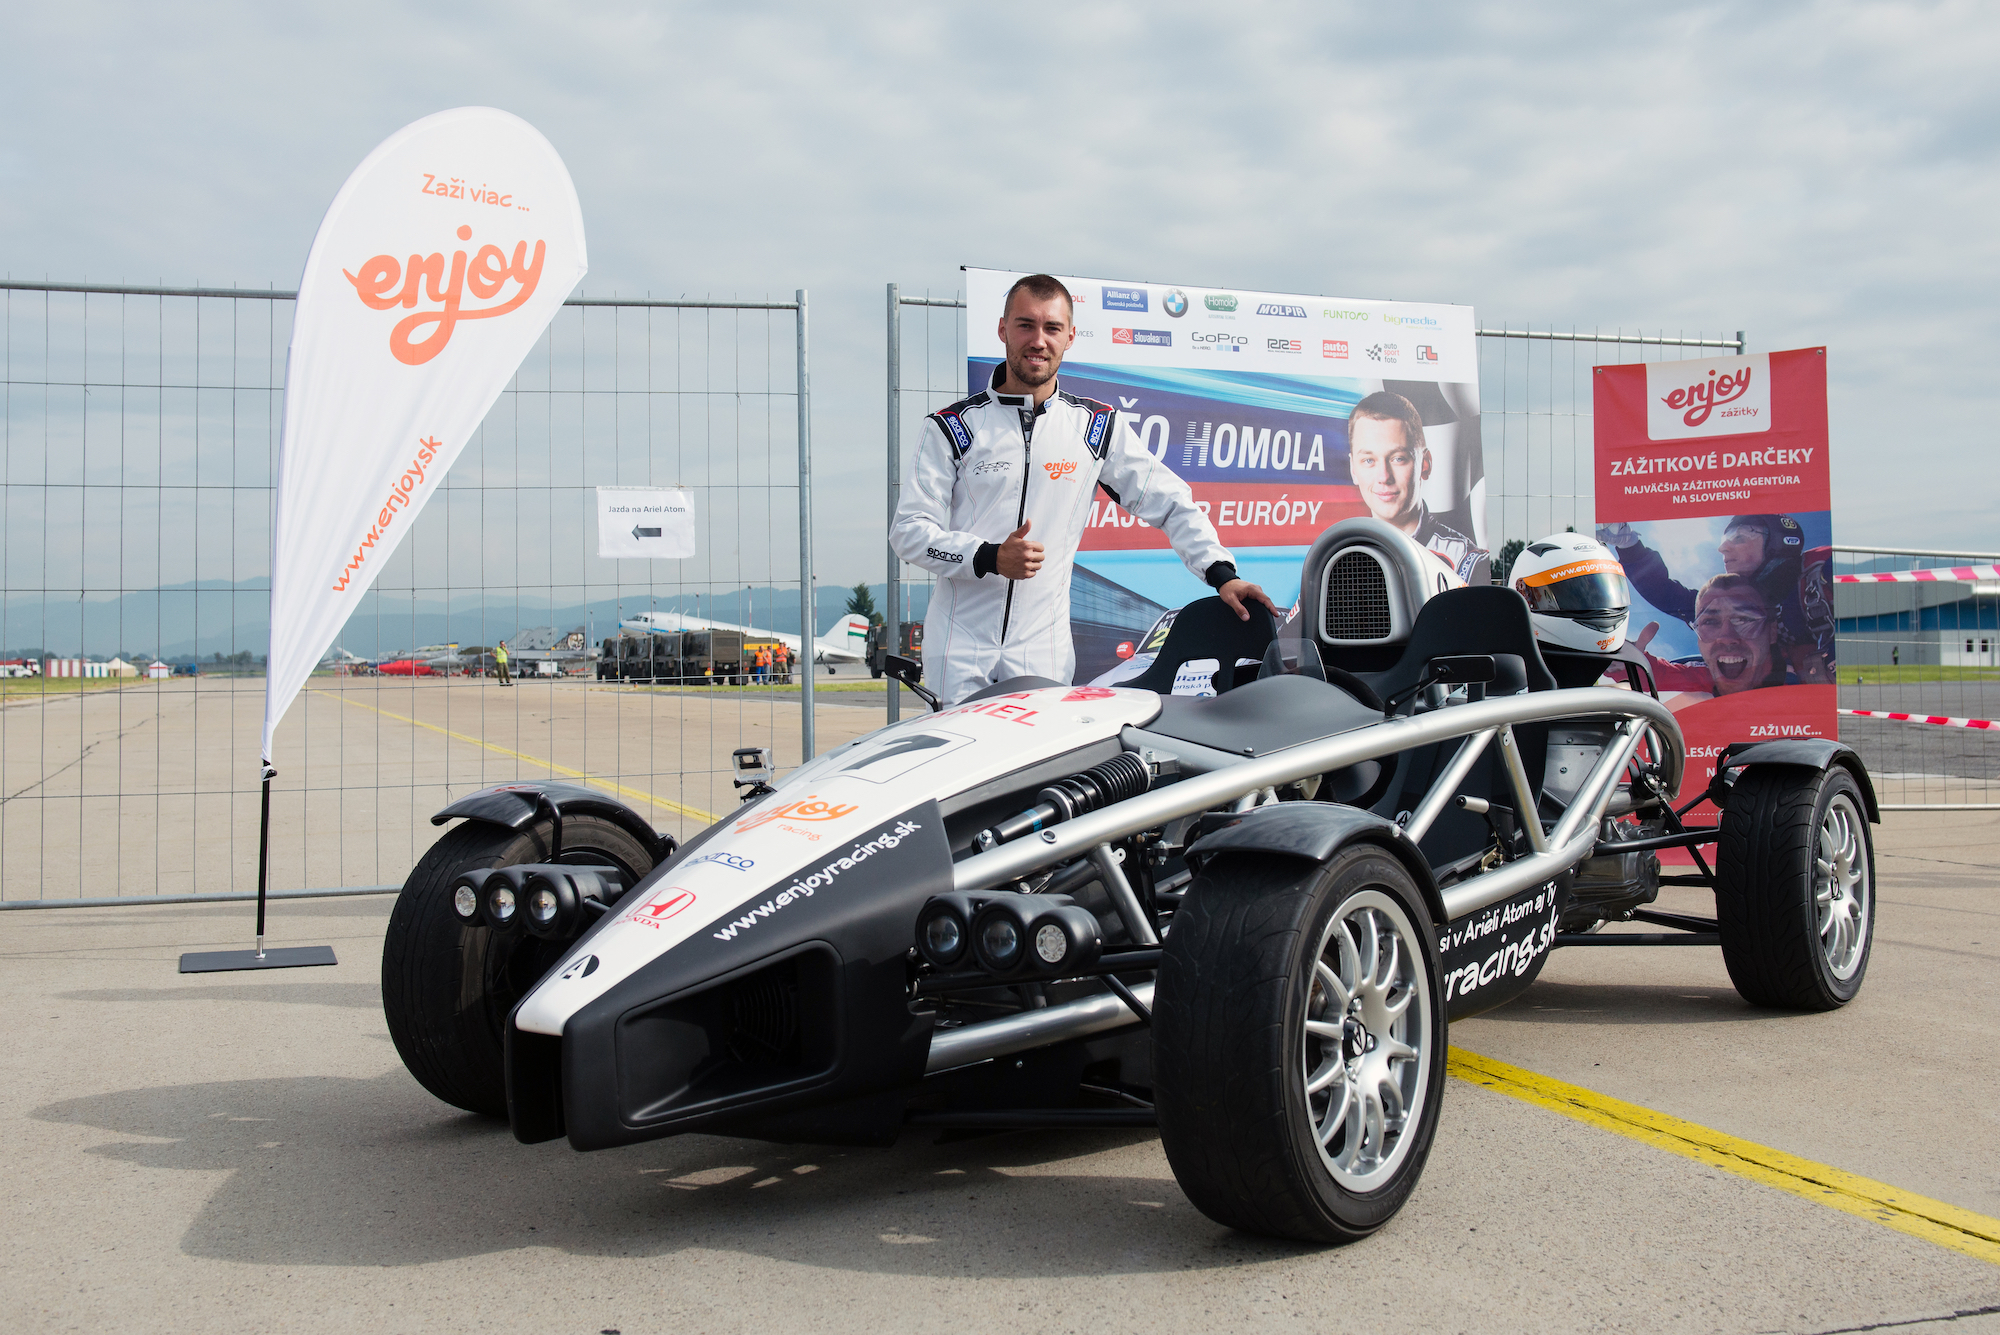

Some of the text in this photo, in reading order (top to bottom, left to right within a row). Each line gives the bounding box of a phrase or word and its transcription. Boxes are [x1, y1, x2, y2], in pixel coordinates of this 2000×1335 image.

[422, 173, 465, 199] Zaži
[470, 183, 513, 208] viac
[342, 225, 546, 366] enjoy
[1107, 291, 1130, 299] Allianz
[1258, 304, 1305, 317] MOLPIR
[1383, 314, 1437, 325] bigmedia
[1191, 332, 1248, 345] GoPro
[1267, 339, 1302, 351] RRS
[1323, 341, 1348, 352] auto
[1661, 366, 1751, 427] enjoy
[1721, 407, 1759, 418] zážitky
[947, 416, 969, 447] sparco
[1090, 414, 1106, 446] sparco
[1182, 421, 1325, 471] HOMOLA
[1042, 459, 1078, 480] enjoy
[1610, 447, 1814, 476] ZÁŽITKOVÉ DARČEKY
[1624, 474, 1801, 495] NAJVÄČŠIA ZÁŽITKOVÁ AGENTÚRA
[1672, 490, 1751, 504] NA SLOVENSKU
[332, 435, 442, 592] www.enjoy.sk
[608, 505, 630, 513] Jazda
[643, 505, 662, 513] Ariel
[664, 505, 686, 513] Atom
[1218, 494, 1323, 526] EURÓPY
[927, 547, 963, 563] sparco
[1461, 552, 1479, 580] parco
[1750, 724, 1822, 737] ZAŽI VIAC...
[733, 795, 859, 834] enjoy
[777, 823, 822, 841] racing
[680, 852, 755, 872] sparco
[713, 820, 922, 941] www.enjoyracing.sk
[613, 916, 661, 930] HONDA
[1439, 881, 1557, 953] si v Arieli Atom aj Ty
[1444, 905, 1559, 1002] racing.sk
